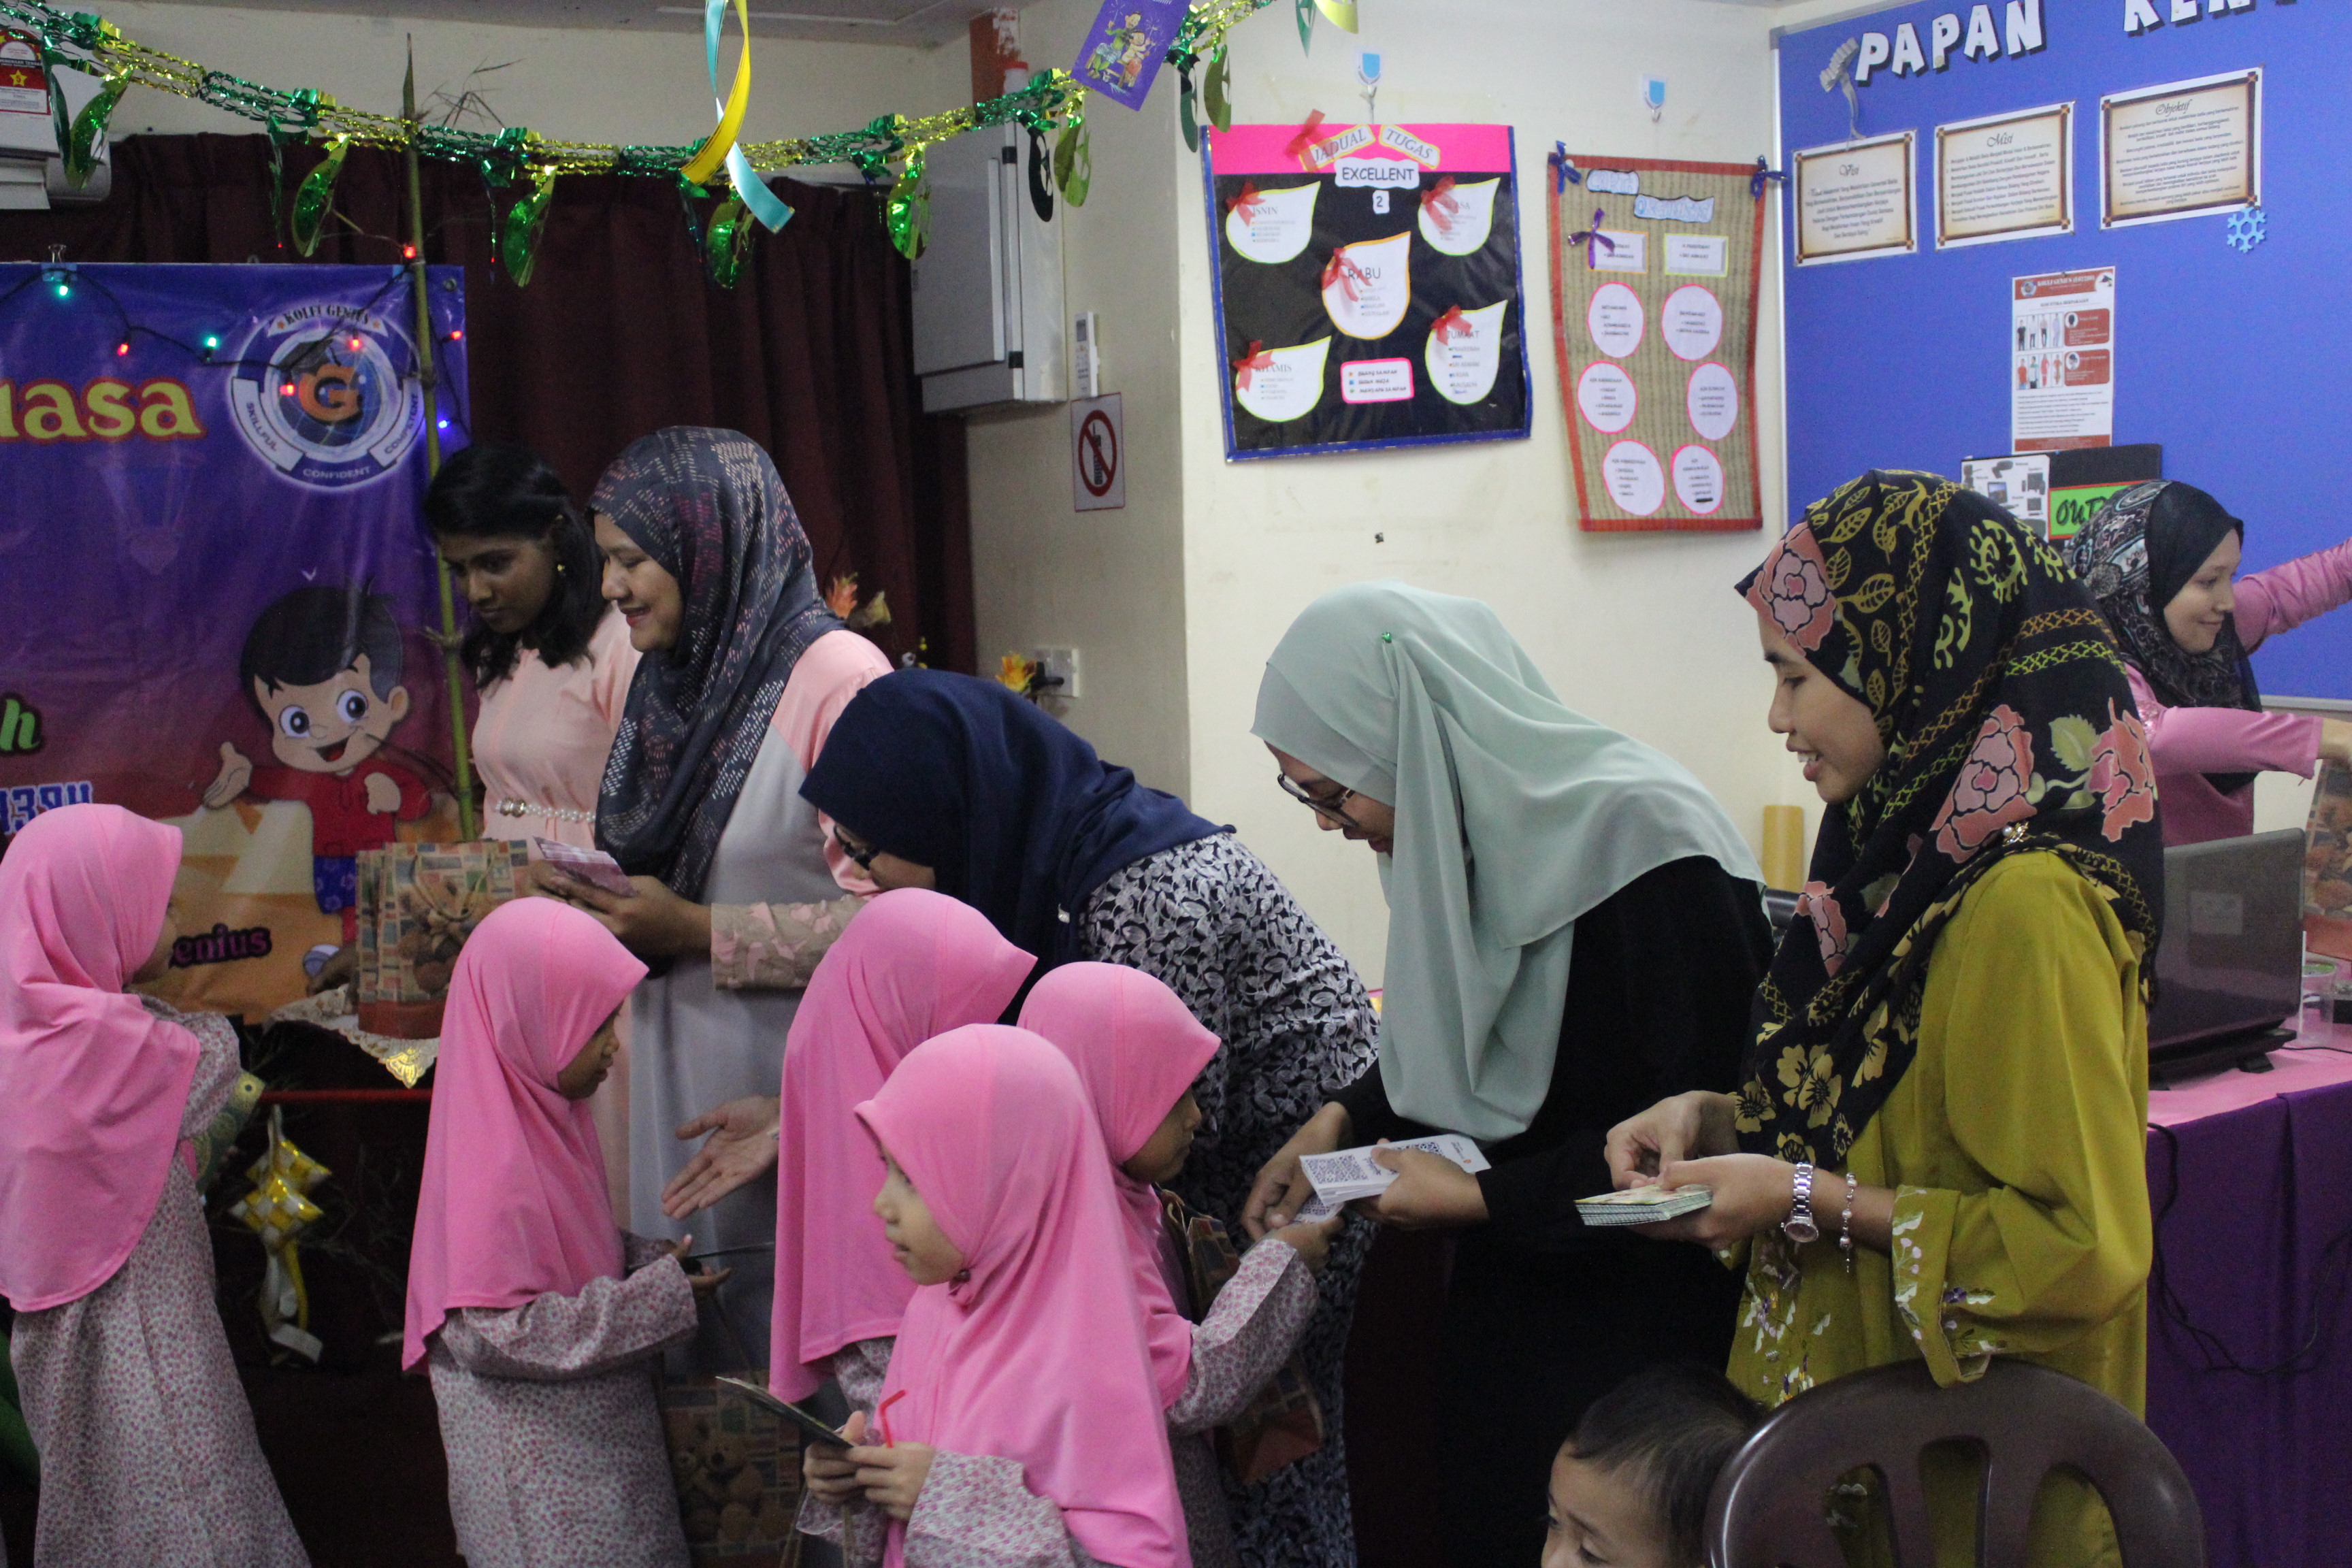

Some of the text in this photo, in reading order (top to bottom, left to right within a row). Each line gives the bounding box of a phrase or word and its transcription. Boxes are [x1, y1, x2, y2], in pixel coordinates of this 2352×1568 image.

[1855, 0, 2044, 83] PAPAN
[2155, 99, 2193, 117] Objektif
[1313, 128, 1434, 162] JADUAL TUGAS
[1987, 132, 2014, 147] Misi
[1342, 167, 1415, 180] EXCELLENT
[1375, 195, 1384, 208] 2
[1253, 206, 1278, 215] ISNIN
[1348, 267, 1381, 279] RABU
[1255, 363, 1292, 373] KHAMIS
[298, 363, 363, 423] G
[169, 923, 272, 968] enius
